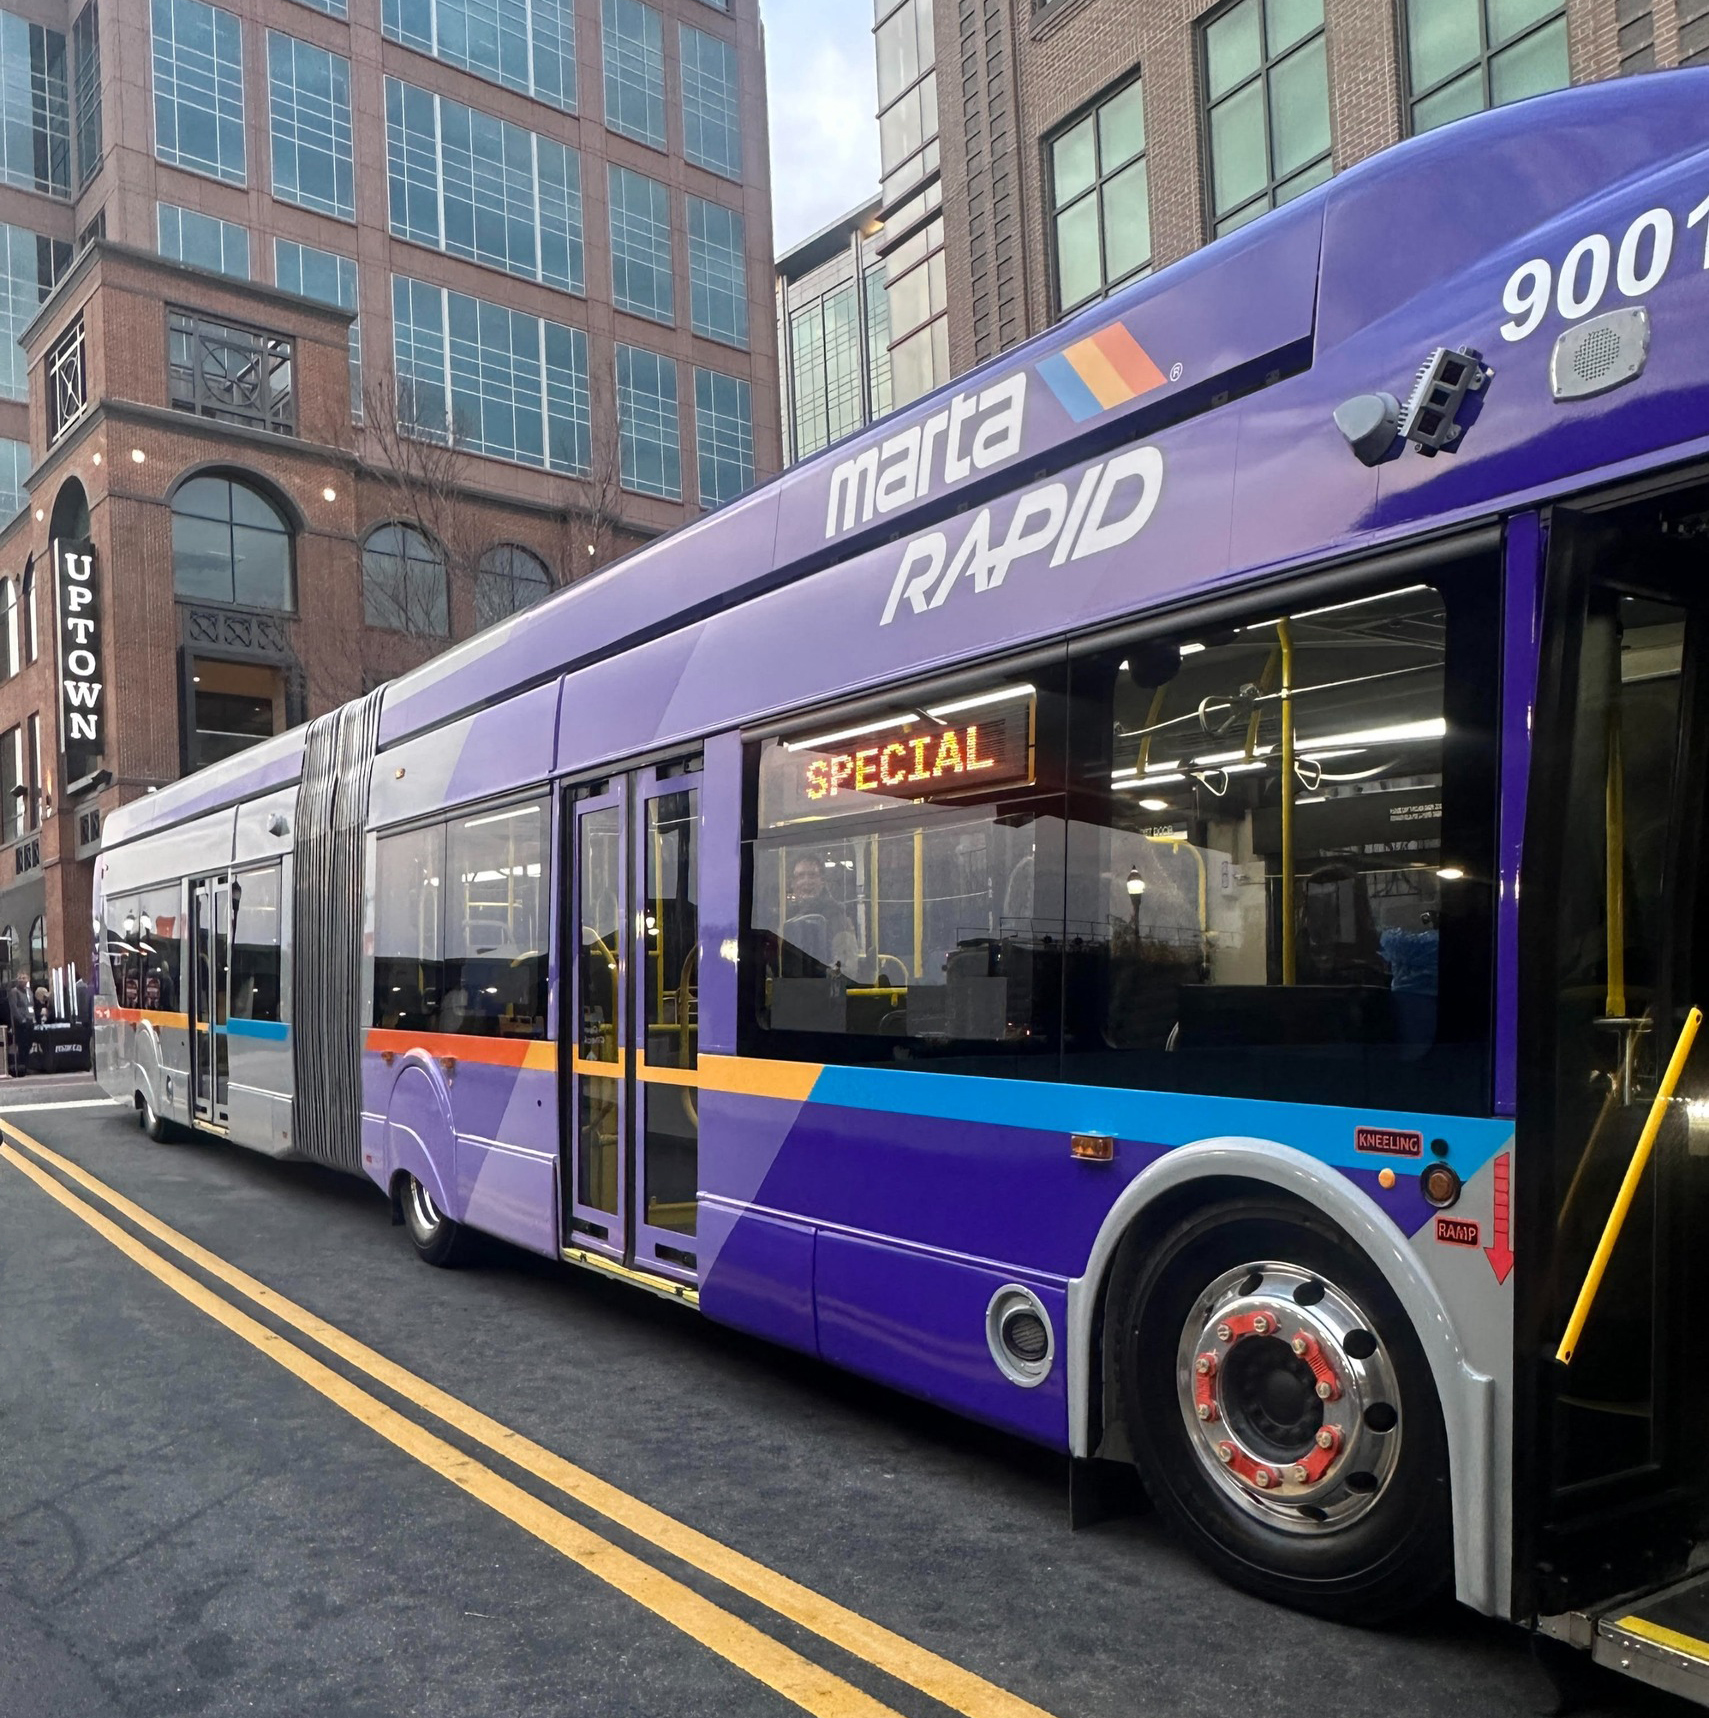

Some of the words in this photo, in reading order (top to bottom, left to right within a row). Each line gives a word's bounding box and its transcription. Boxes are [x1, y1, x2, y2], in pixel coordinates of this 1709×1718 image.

[825, 371, 1027, 539] marta
[879, 445, 1164, 626] RAPID
[64, 552, 102, 740] UPTOWN
[805, 725, 995, 800] SPECIAL
[1359, 1132, 1418, 1152] KNEELING
[1438, 1222, 1477, 1242] RAMP
